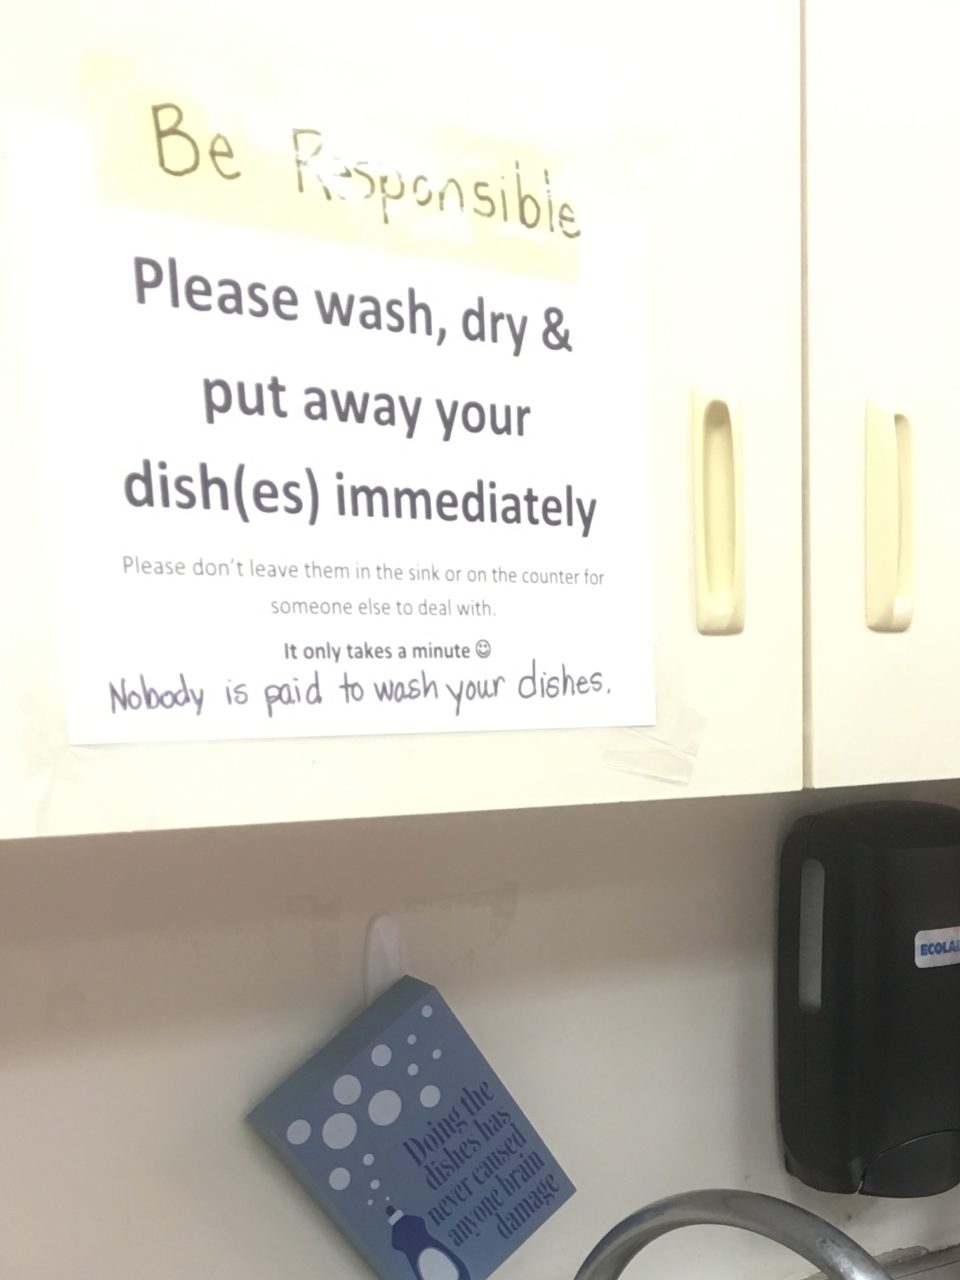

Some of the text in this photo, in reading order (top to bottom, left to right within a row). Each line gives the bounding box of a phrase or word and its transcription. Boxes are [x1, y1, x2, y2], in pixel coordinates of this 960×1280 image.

[151, 102, 582, 240] Be Responsible
[133, 256, 573, 358] Please wash, dry &
[202, 375, 532, 446] put away your
[124, 458, 597, 538] dish(es) immediately
[122, 555, 186, 576] Please
[249, 558, 299, 579] leave
[303, 560, 351, 579] them
[355, 560, 371, 580] in
[375, 562, 404, 581] the
[408, 563, 441, 582] sink
[444, 568, 462, 582] or
[466, 569, 487, 583] on
[491, 566, 518, 584] the
[521, 569, 580, 585] counter
[583, 568, 605, 586] for
[270, 597, 497, 617] someone else to deal with.
[108, 657, 611, 719] Nobody is paid to wash your dishes.
[284, 641, 471, 664] It only takes a minute
[402, 1081, 495, 1167] Doing the
[424, 1106, 511, 1190] dishes has
[428, 1122, 527, 1227] never caused
[448, 1151, 545, 1247] anyone brain
[495, 1173, 560, 1239] damage
